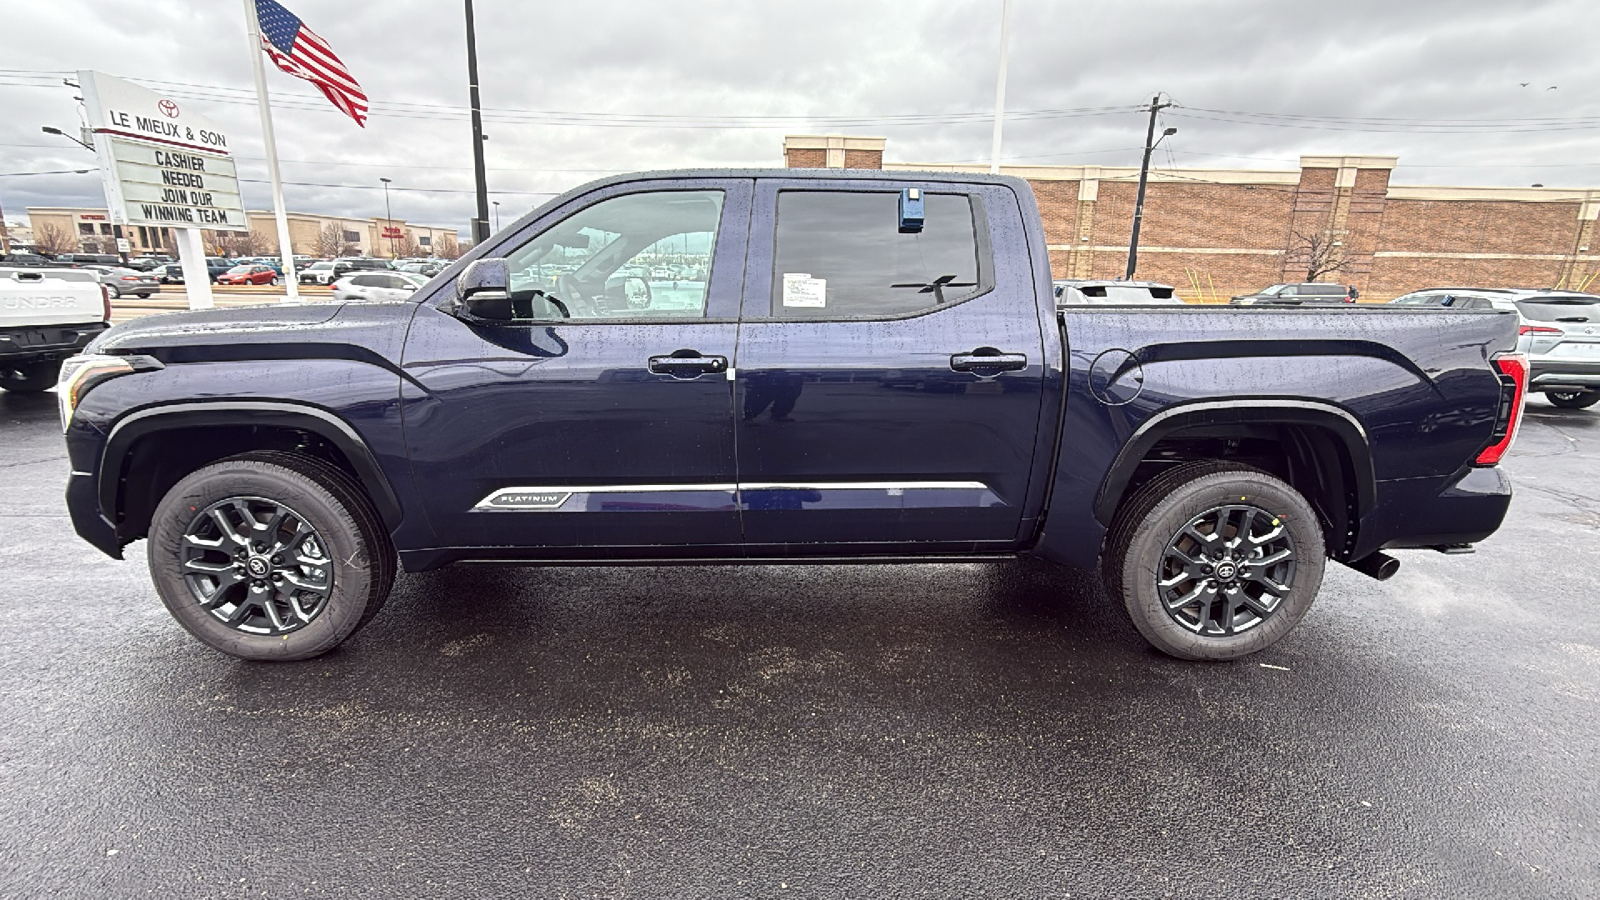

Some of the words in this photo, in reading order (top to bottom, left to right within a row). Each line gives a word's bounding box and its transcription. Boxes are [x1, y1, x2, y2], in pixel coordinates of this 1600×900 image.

[110, 110, 131, 128] LE
[135, 116, 181, 138] MIEUX
[186, 127, 195, 141] &
[200, 129, 227, 147] SON
[155, 151, 205, 172] CASHIER
[161, 170, 204, 189] NEEDED
[161, 188, 188, 204] JOIN
[191, 191, 213, 206] OUR
[141, 204, 193, 222] WINNING
[197, 208, 228, 224] TEAM
[2, 296, 78, 309] UNDRA
